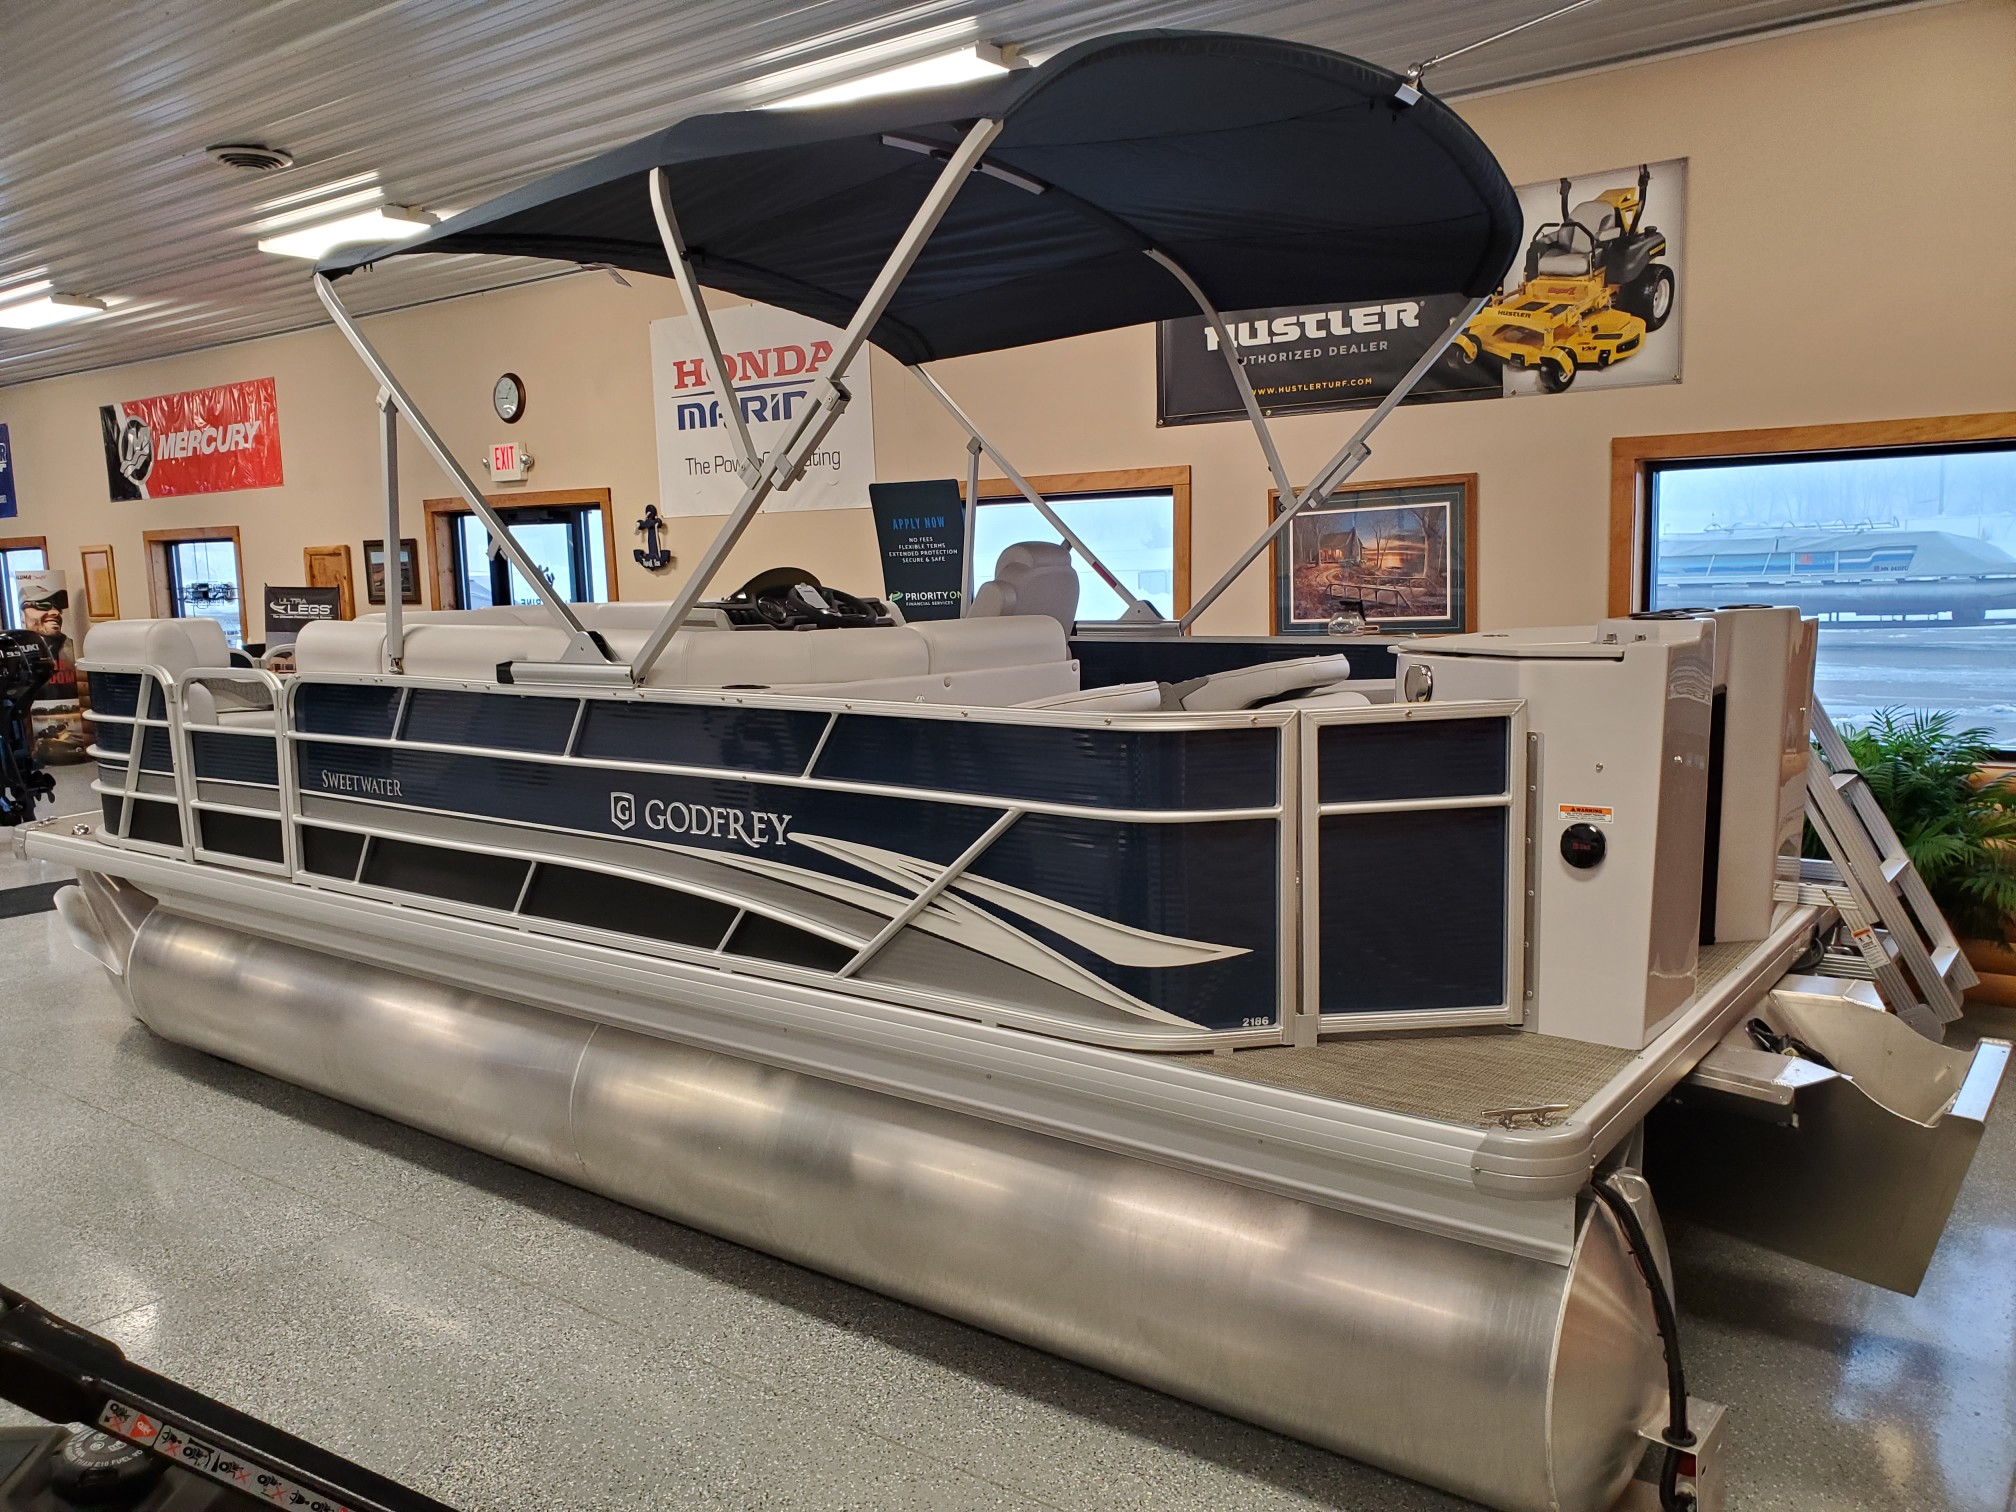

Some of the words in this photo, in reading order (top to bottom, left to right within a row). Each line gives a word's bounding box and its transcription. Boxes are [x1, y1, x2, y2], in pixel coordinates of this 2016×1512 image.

[1497, 310, 1532, 319] HUSTLER
[1204, 301, 1420, 351] HUSTLER
[1241, 348, 1322, 367] UTHORIZED
[1328, 341, 1389, 356] DEALER
[672, 340, 834, 390] HONDA
[677, 391, 809, 431] MARIN
[157, 420, 261, 461] MERCURY
[494, 445, 514, 471] EXIT
[685, 457, 711, 475] The
[714, 454, 754, 473] Pow
[892, 517, 920, 530] APPLY
[924, 516, 945, 529] NOW
[278, 597, 307, 605] ULTRA
[905, 591, 948, 601] PRIORITY
[949, 590, 962, 599] ON
[287, 604, 331, 615] LEGS
[644, 799, 793, 848] GODFREY
[1241, 1016, 1270, 1027] 2186
[111, 1455, 132, 1466] FUEL
